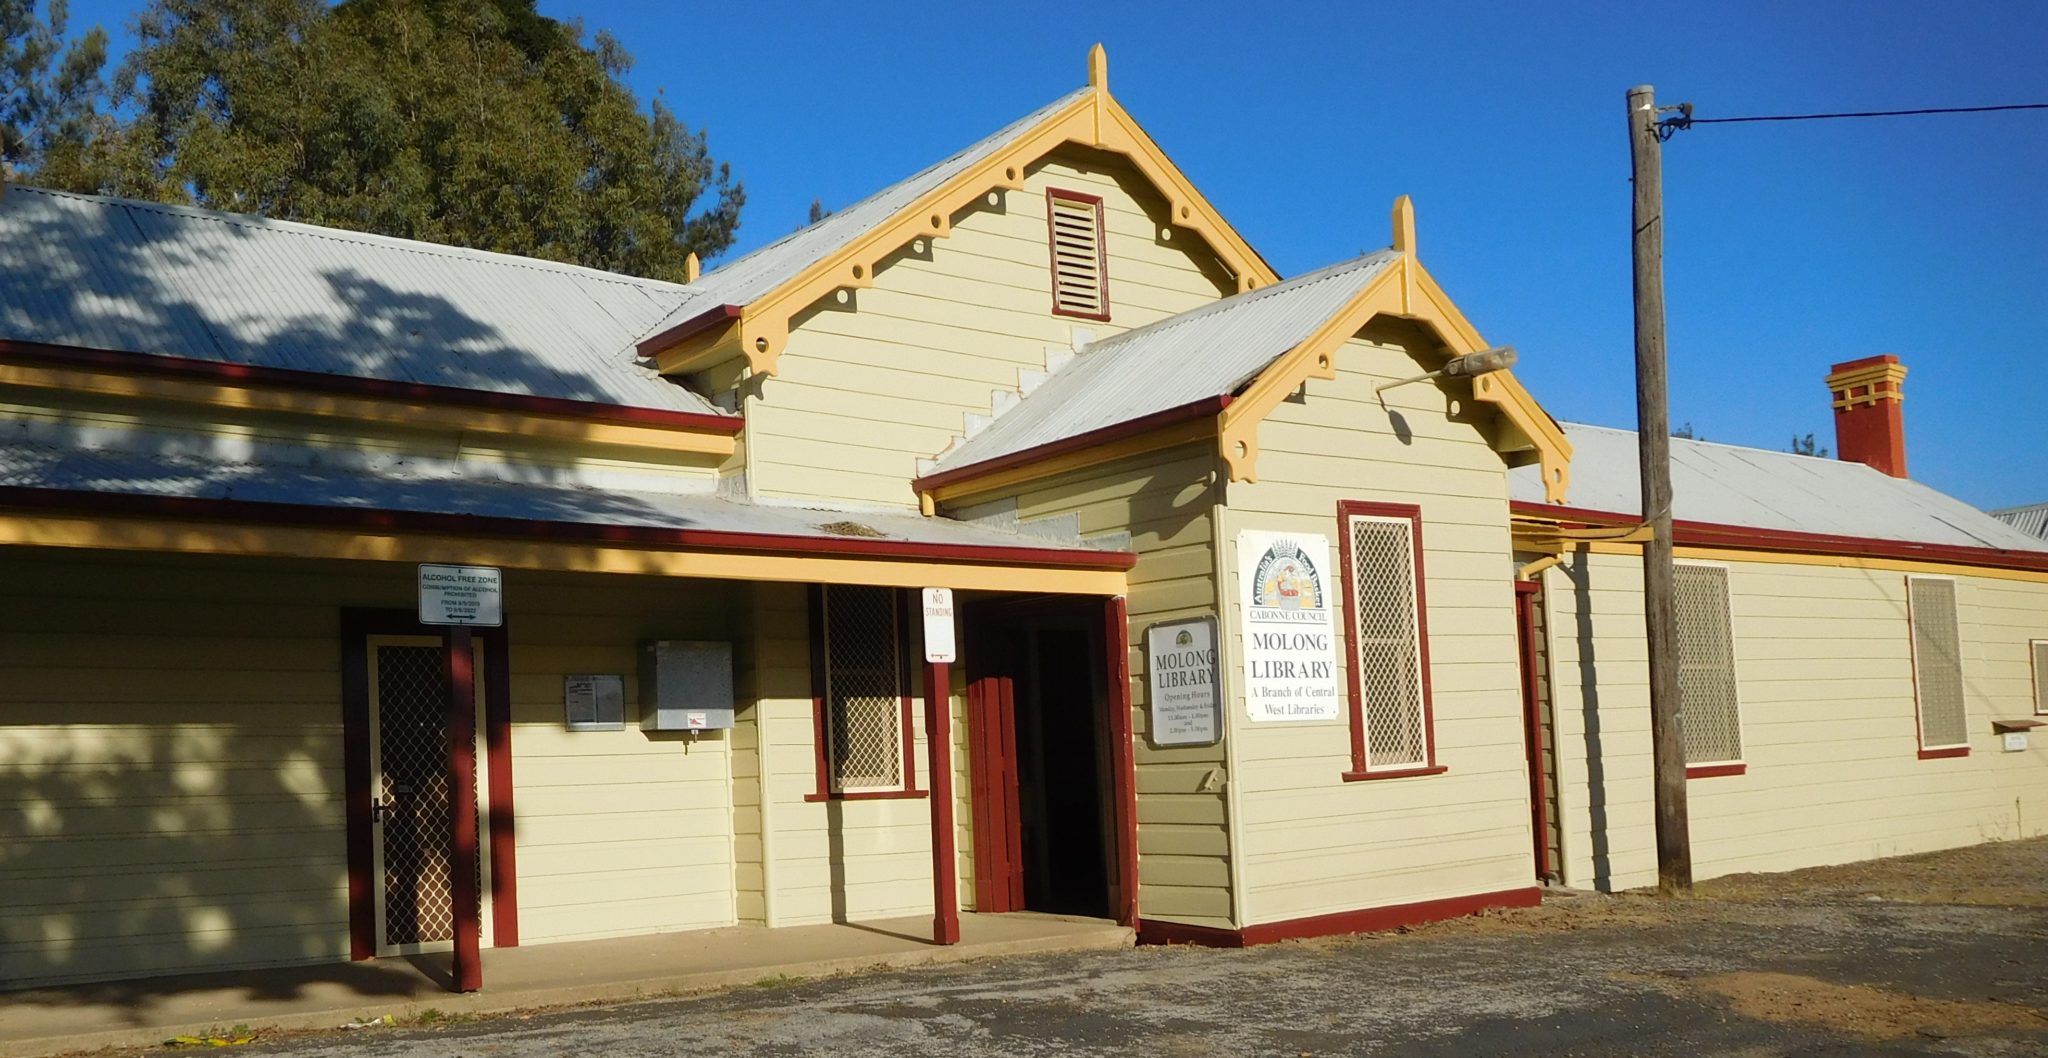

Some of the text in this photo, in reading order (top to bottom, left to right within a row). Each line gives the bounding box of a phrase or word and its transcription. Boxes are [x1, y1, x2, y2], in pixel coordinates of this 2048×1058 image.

[1299, 551, 1315, 574] Food
[422, 574, 456, 582] ALCOHOL
[478, 576, 498, 584] ZONE
[1254, 555, 1273, 603] Australia's
[932, 593, 943, 604] NO
[925, 607, 951, 616] STANDING
[1249, 609, 1327, 622] CABONNE COUNCIL
[1252, 632, 1328, 651] MOLONG
[1156, 648, 1216, 671] MOLONG
[1251, 660, 1332, 679] LIBRARY
[1158, 668, 1215, 689] LIBRARY
[1164, 690, 1210, 703] Opening Hours
[1251, 686, 1335, 698] A Branch of Central
[1264, 703, 1325, 715] West Libraries
